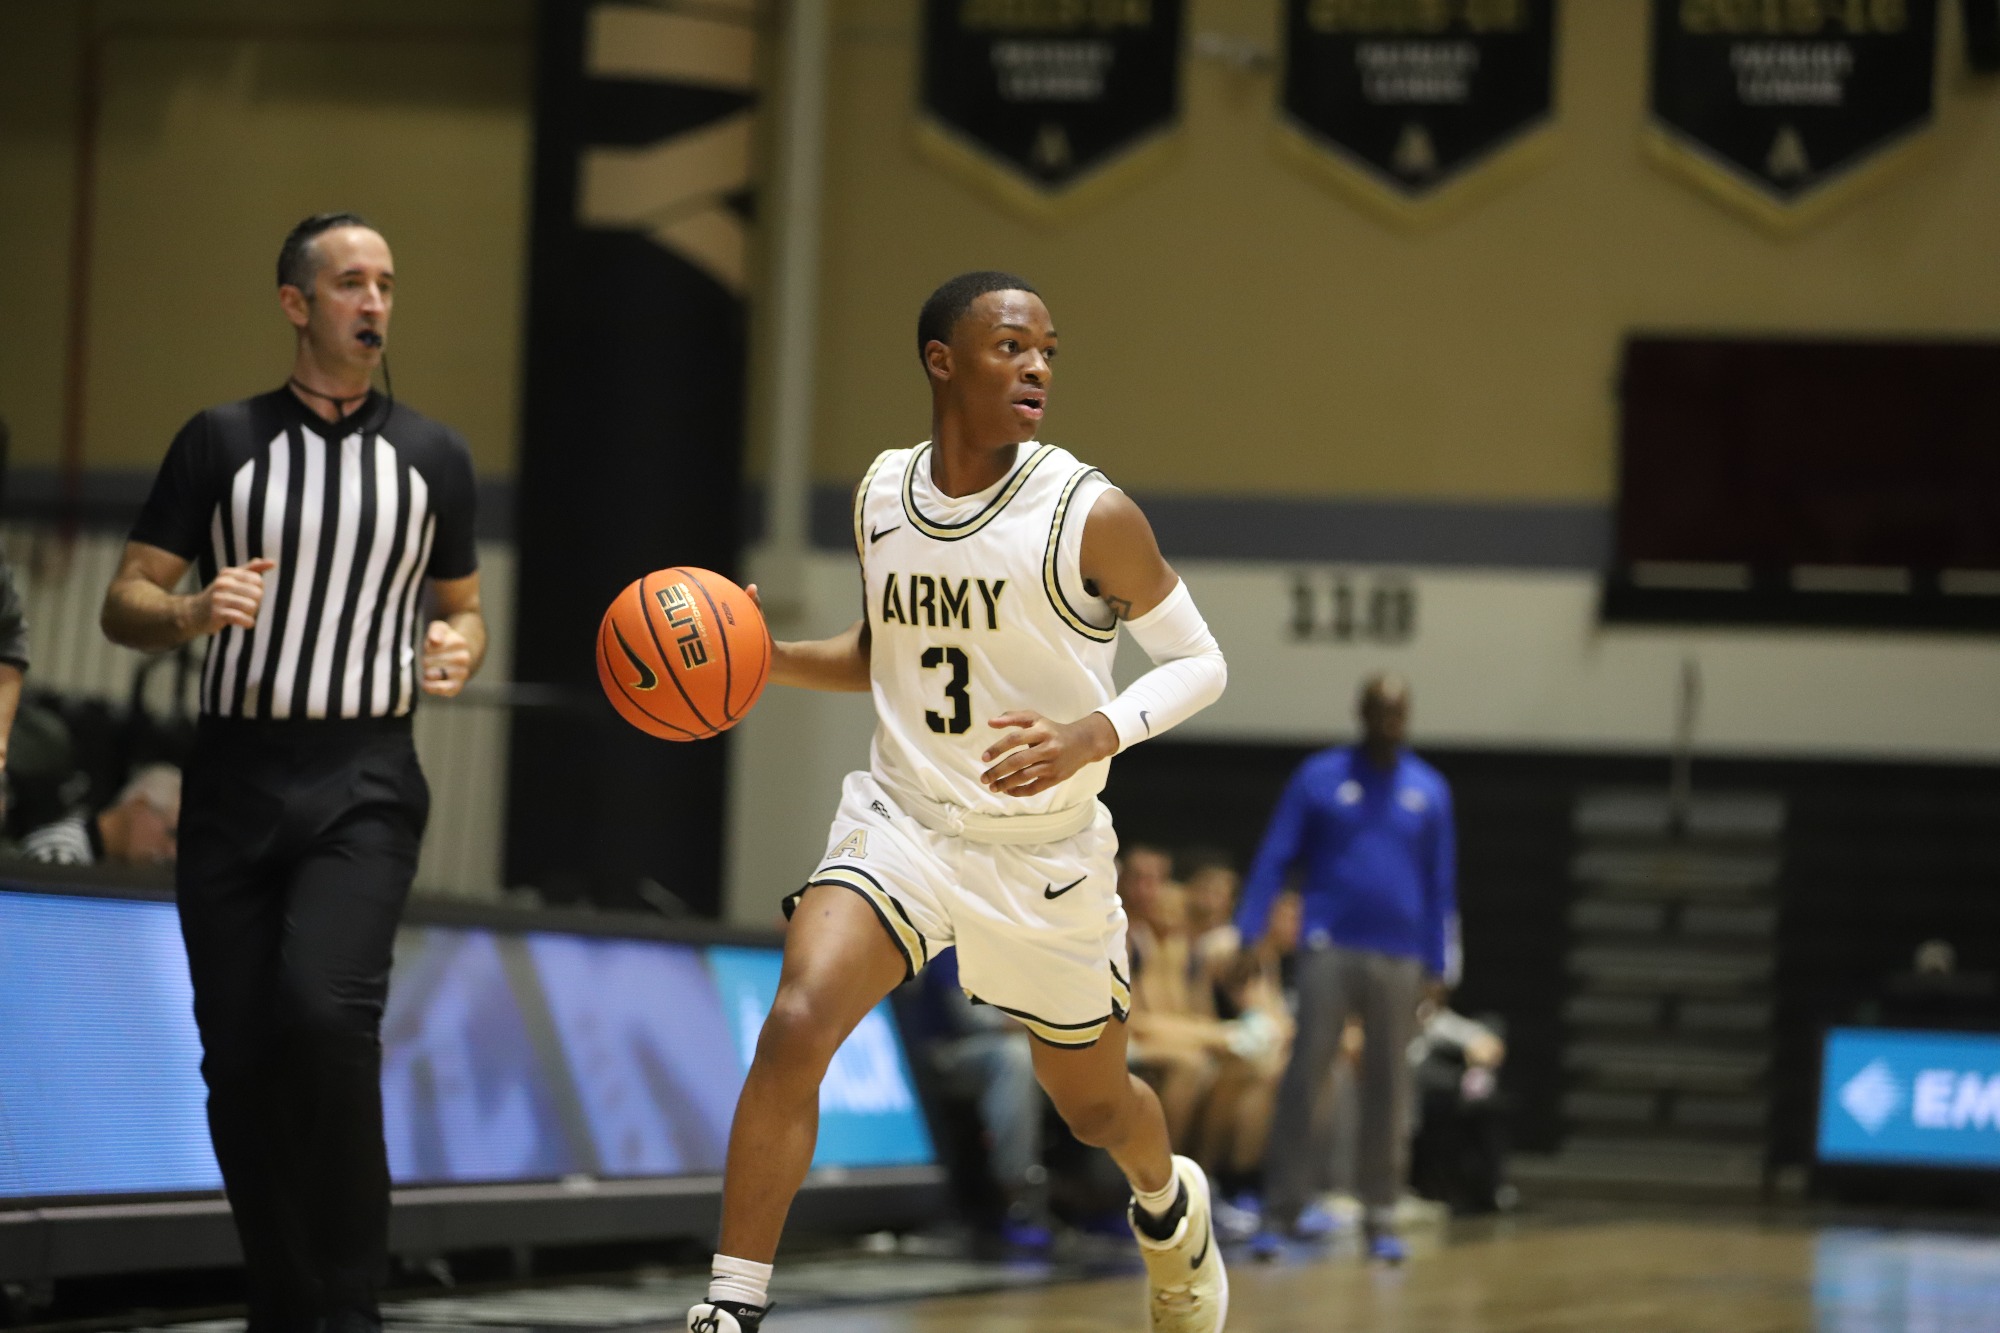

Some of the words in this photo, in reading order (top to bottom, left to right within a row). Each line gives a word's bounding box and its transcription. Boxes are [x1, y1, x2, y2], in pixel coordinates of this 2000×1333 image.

[655, 584, 709, 671] ELITE
[882, 571, 1009, 631] ARMY
[920, 645, 972, 735] 3
[827, 828, 868, 859] A
